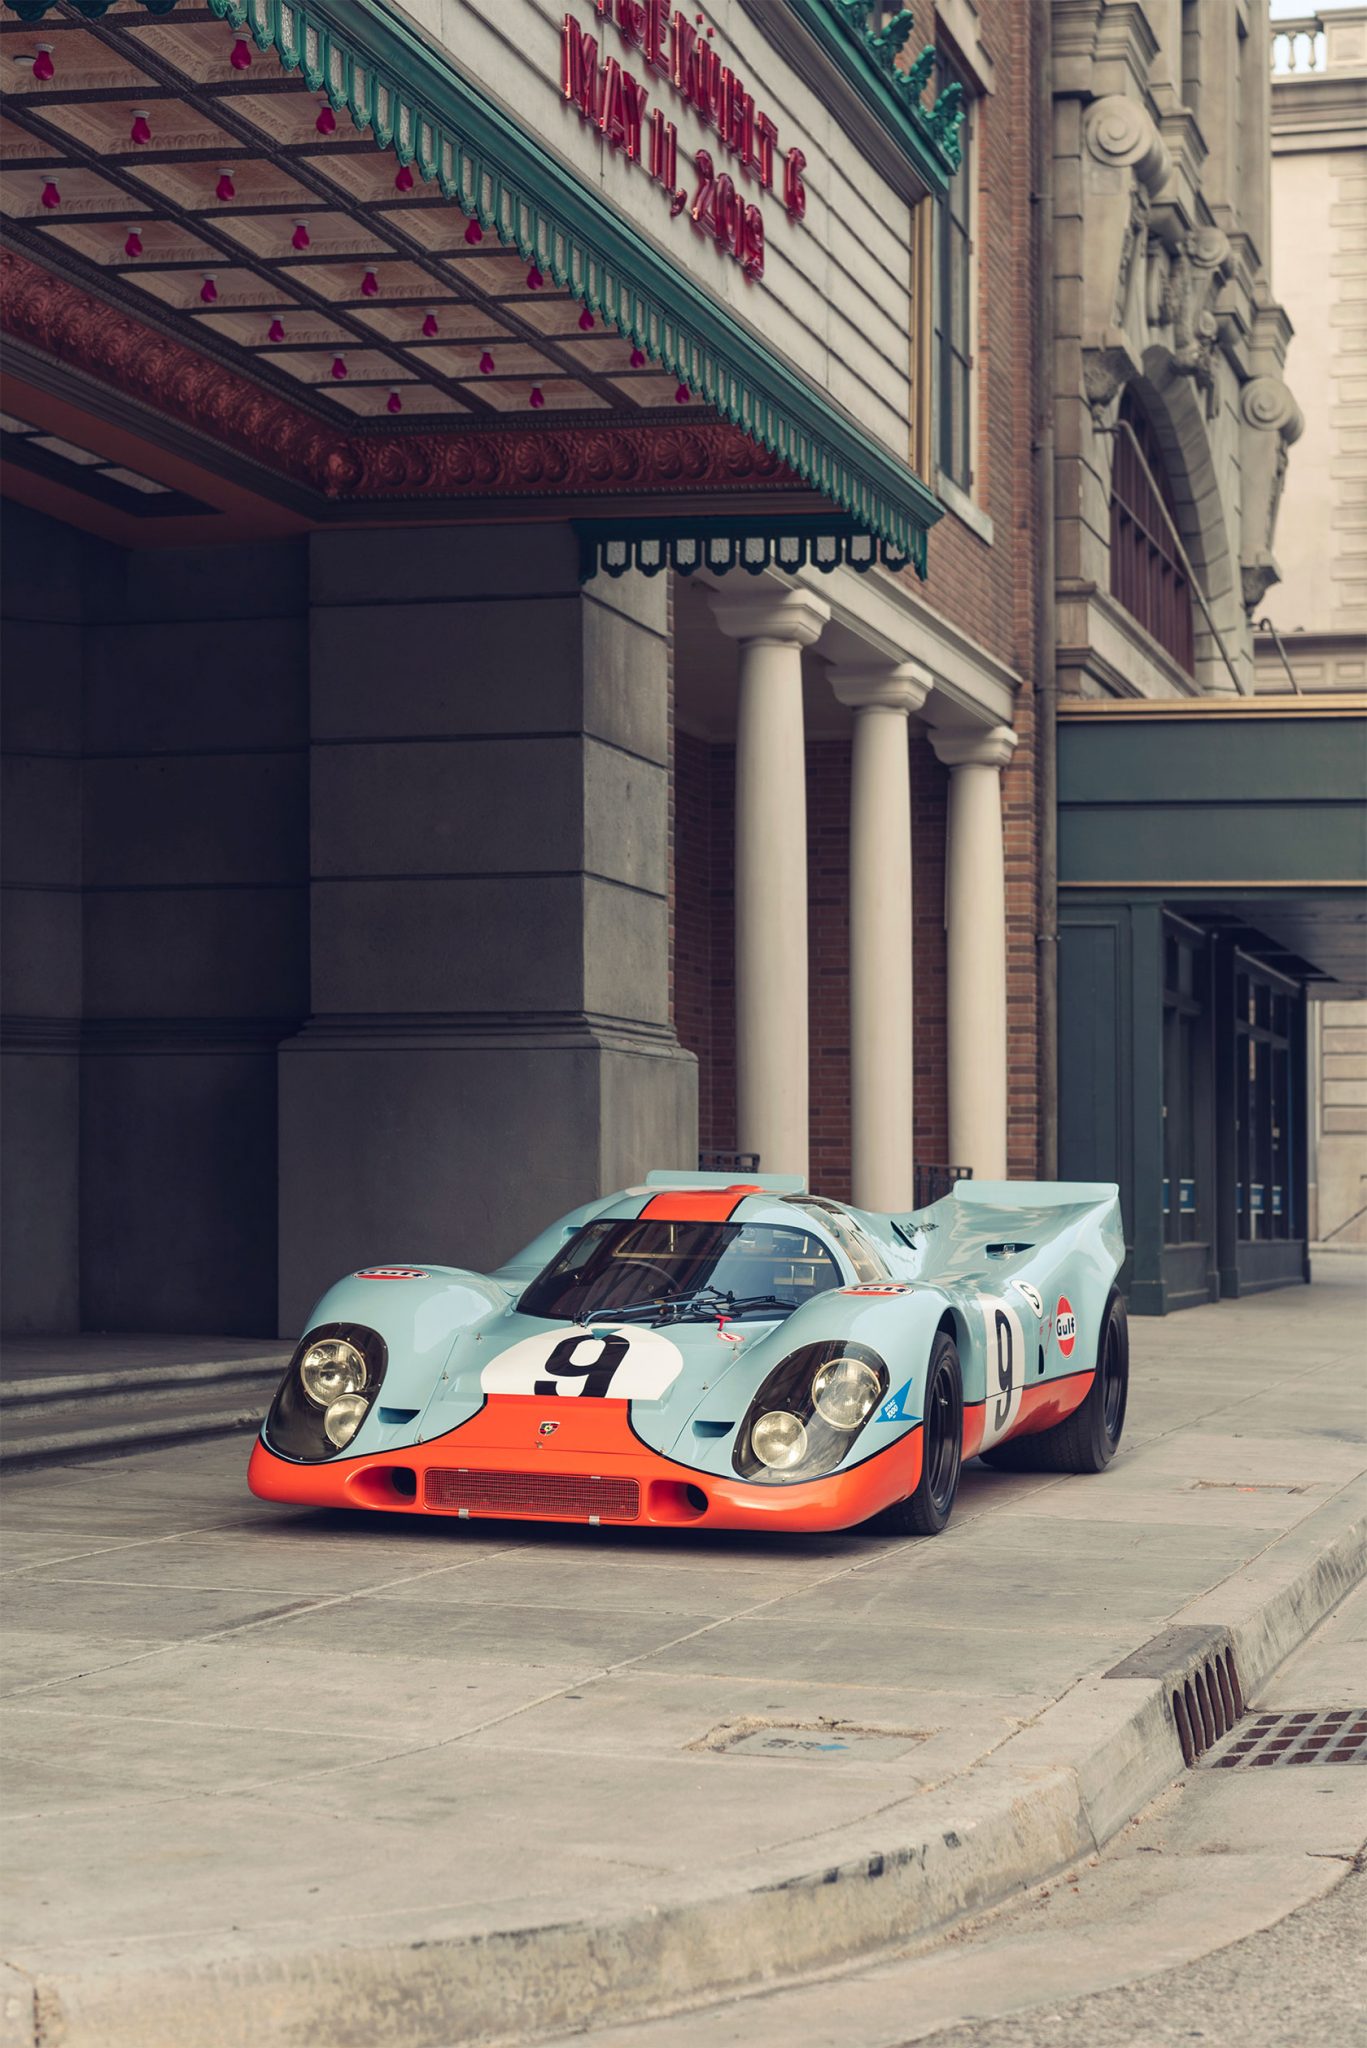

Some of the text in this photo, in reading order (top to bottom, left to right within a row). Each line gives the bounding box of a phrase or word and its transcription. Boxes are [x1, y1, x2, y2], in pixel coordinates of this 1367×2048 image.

[562, 13, 649, 166] MAY
[594, 0, 807, 224] GEKÜHLT 6
[534, 1334, 630, 1398] 9
[994, 1309, 1013, 1431] 9
[1056, 1317, 1075, 1337] Gulf
